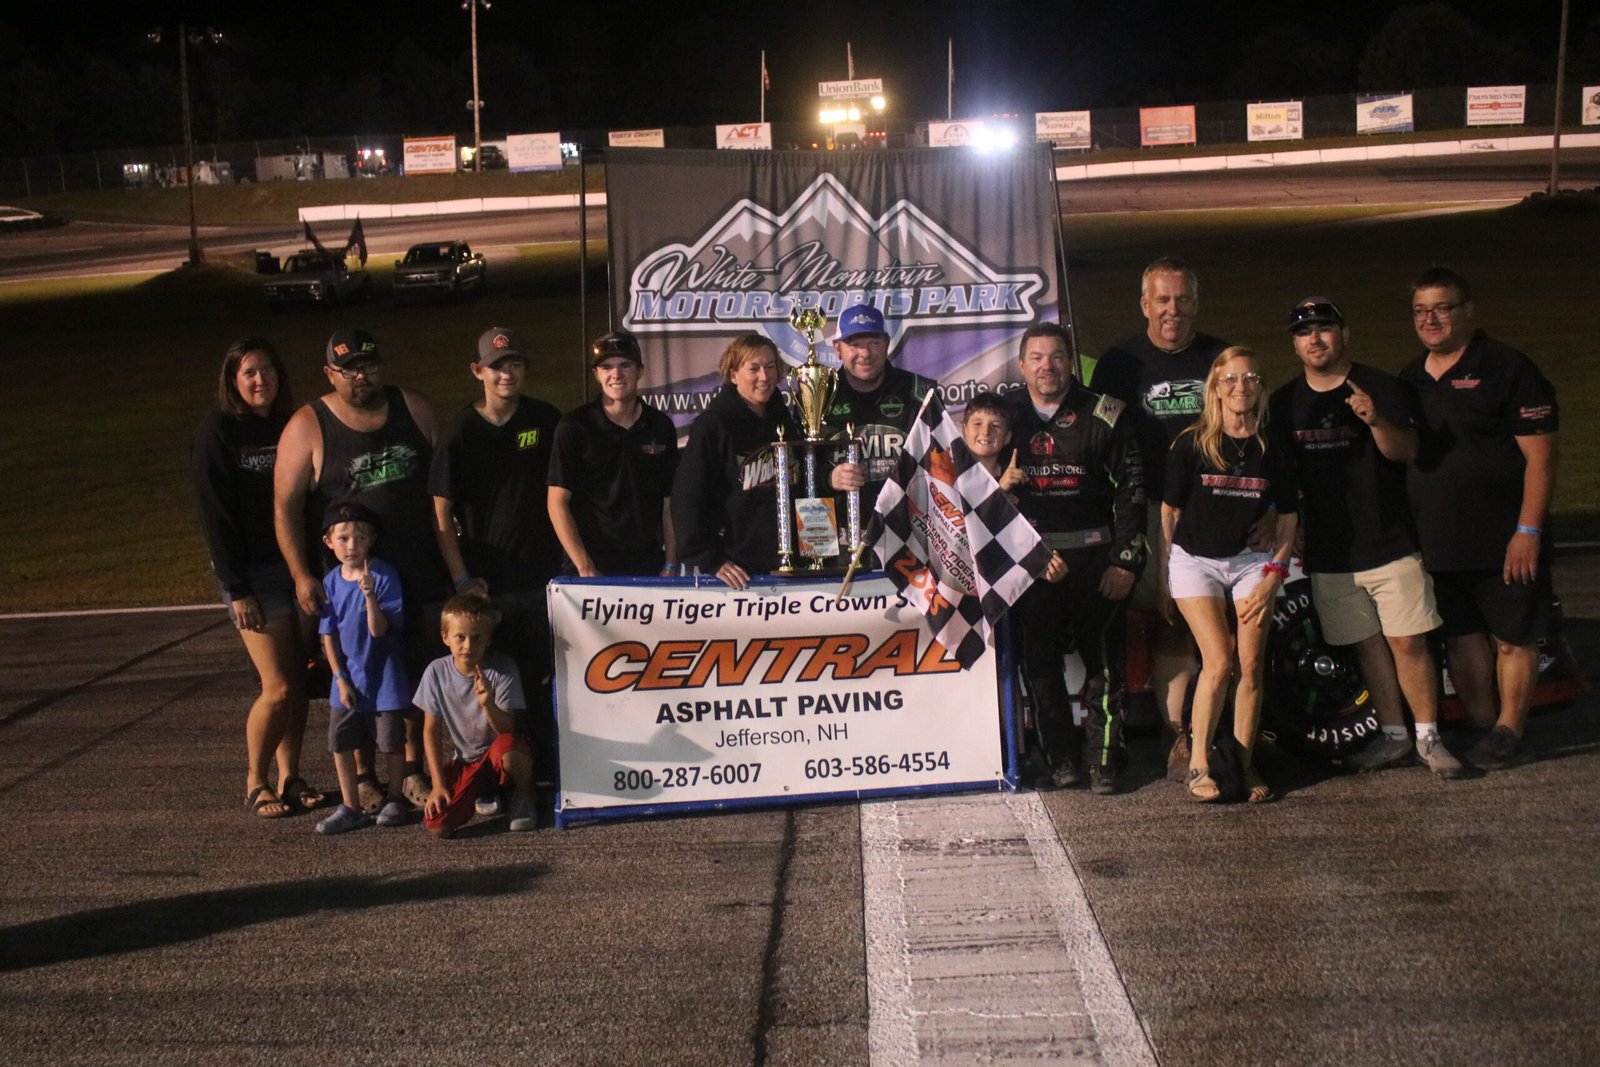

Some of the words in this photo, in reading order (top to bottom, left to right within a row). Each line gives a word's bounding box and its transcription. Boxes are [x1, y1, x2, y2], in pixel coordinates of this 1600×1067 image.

[820, 82, 880, 94] UnionBank
[725, 125, 761, 140] ACT
[638, 245, 775, 298] White
[774, 241, 943, 295] Mountain
[633, 286, 915, 320] MOTORSPORTS
[914, 282, 1027, 315] PARK
[361, 342, 375, 352] 12
[1153, 395, 1197, 410] TWR
[517, 429, 538, 449] 78
[1052, 463, 1086, 475] STORE
[921, 514, 948, 551] FLYING
[932, 506, 955, 534] ASPHALT
[911, 514, 942, 553] TRIPLE
[939, 552, 976, 592] CROWN
[581, 597, 654, 626] Flying
[662, 598, 726, 625] Tiger
[733, 596, 802, 621] Triple
[809, 594, 888, 613] Crown
[584, 628, 963, 694] CENTRAL
[656, 696, 788, 724] ASPHALT
[798, 689, 904, 715] PAVING
[715, 728, 811, 748] Jefferson,
[817, 722, 848, 741] NH
[613, 763, 762, 791] 800-287-6007
[804, 751, 950, 779] 603-586-4554
